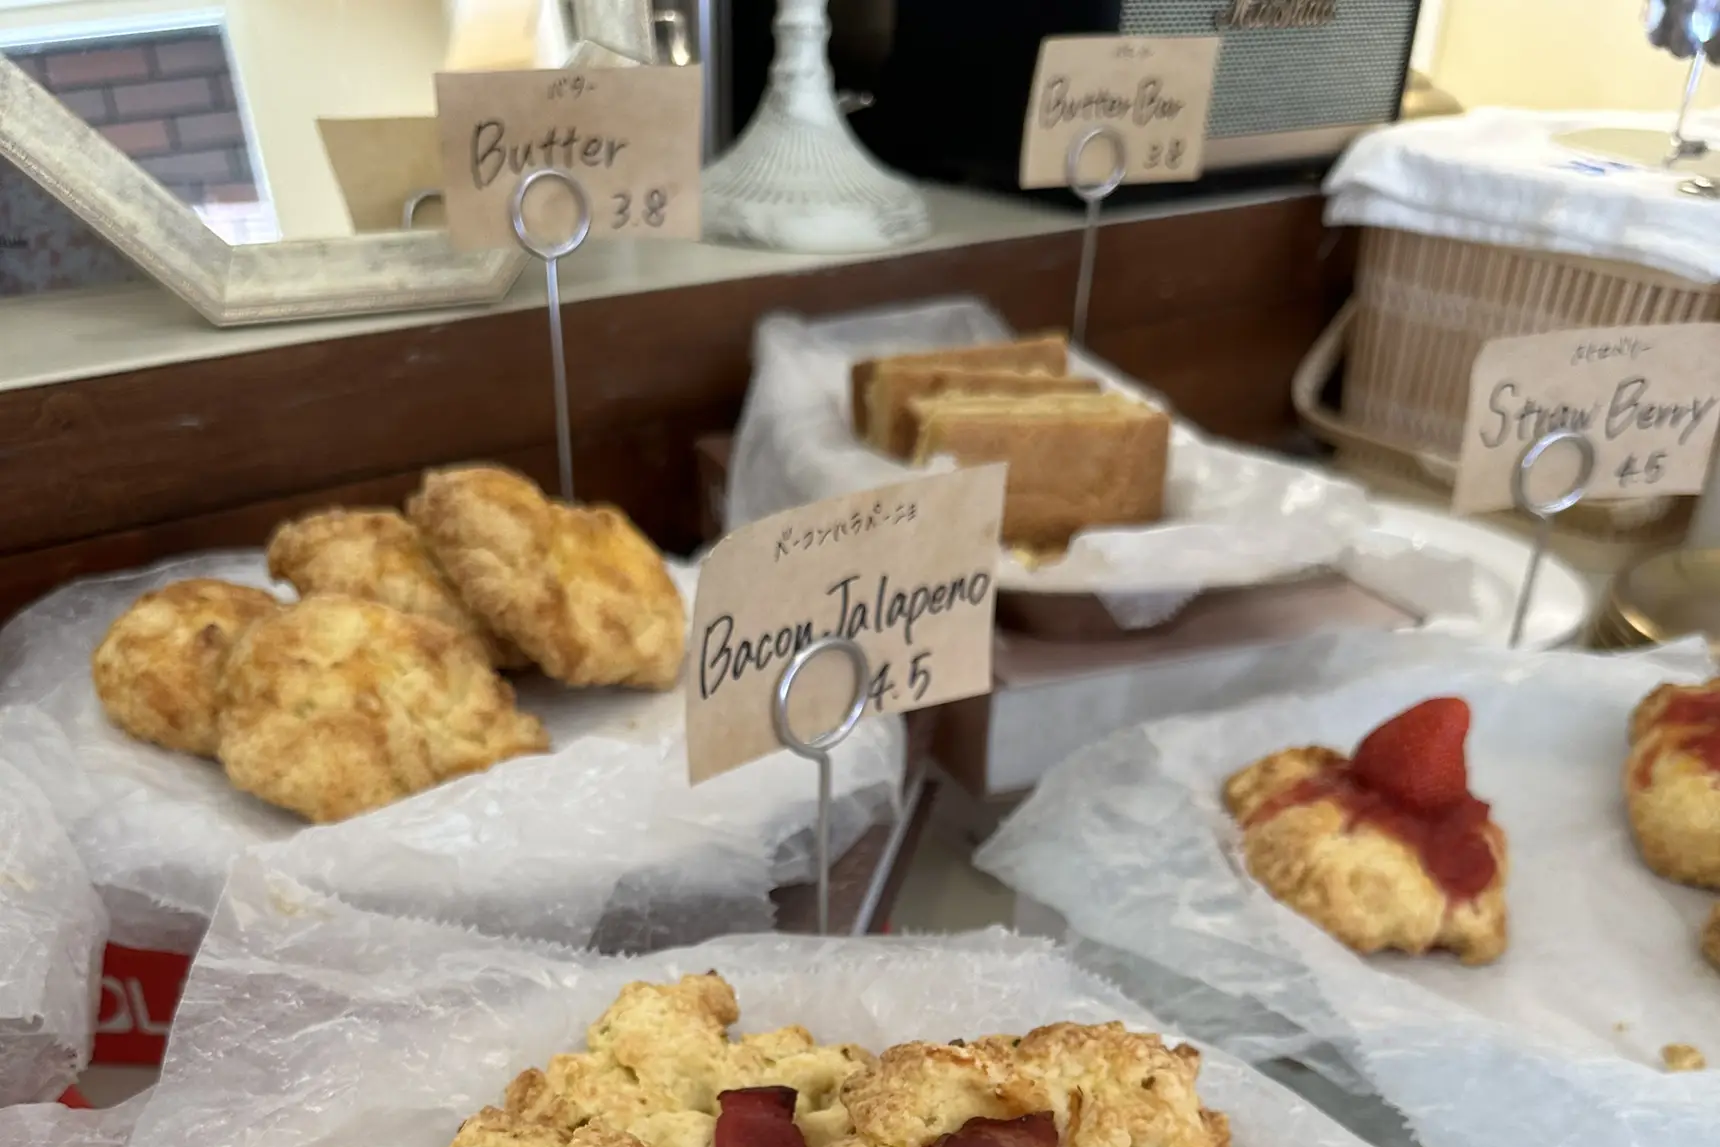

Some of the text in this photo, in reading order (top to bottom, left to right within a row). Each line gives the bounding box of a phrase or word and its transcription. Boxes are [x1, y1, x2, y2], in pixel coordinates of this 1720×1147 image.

[1038, 75, 1131, 129] Butter
[470, 119, 629, 190] Butter
[1479, 376, 1719, 449] Straw Berry
[700, 571, 991, 700] Bacon Jalapeno
[868, 651, 934, 713] 4.5
